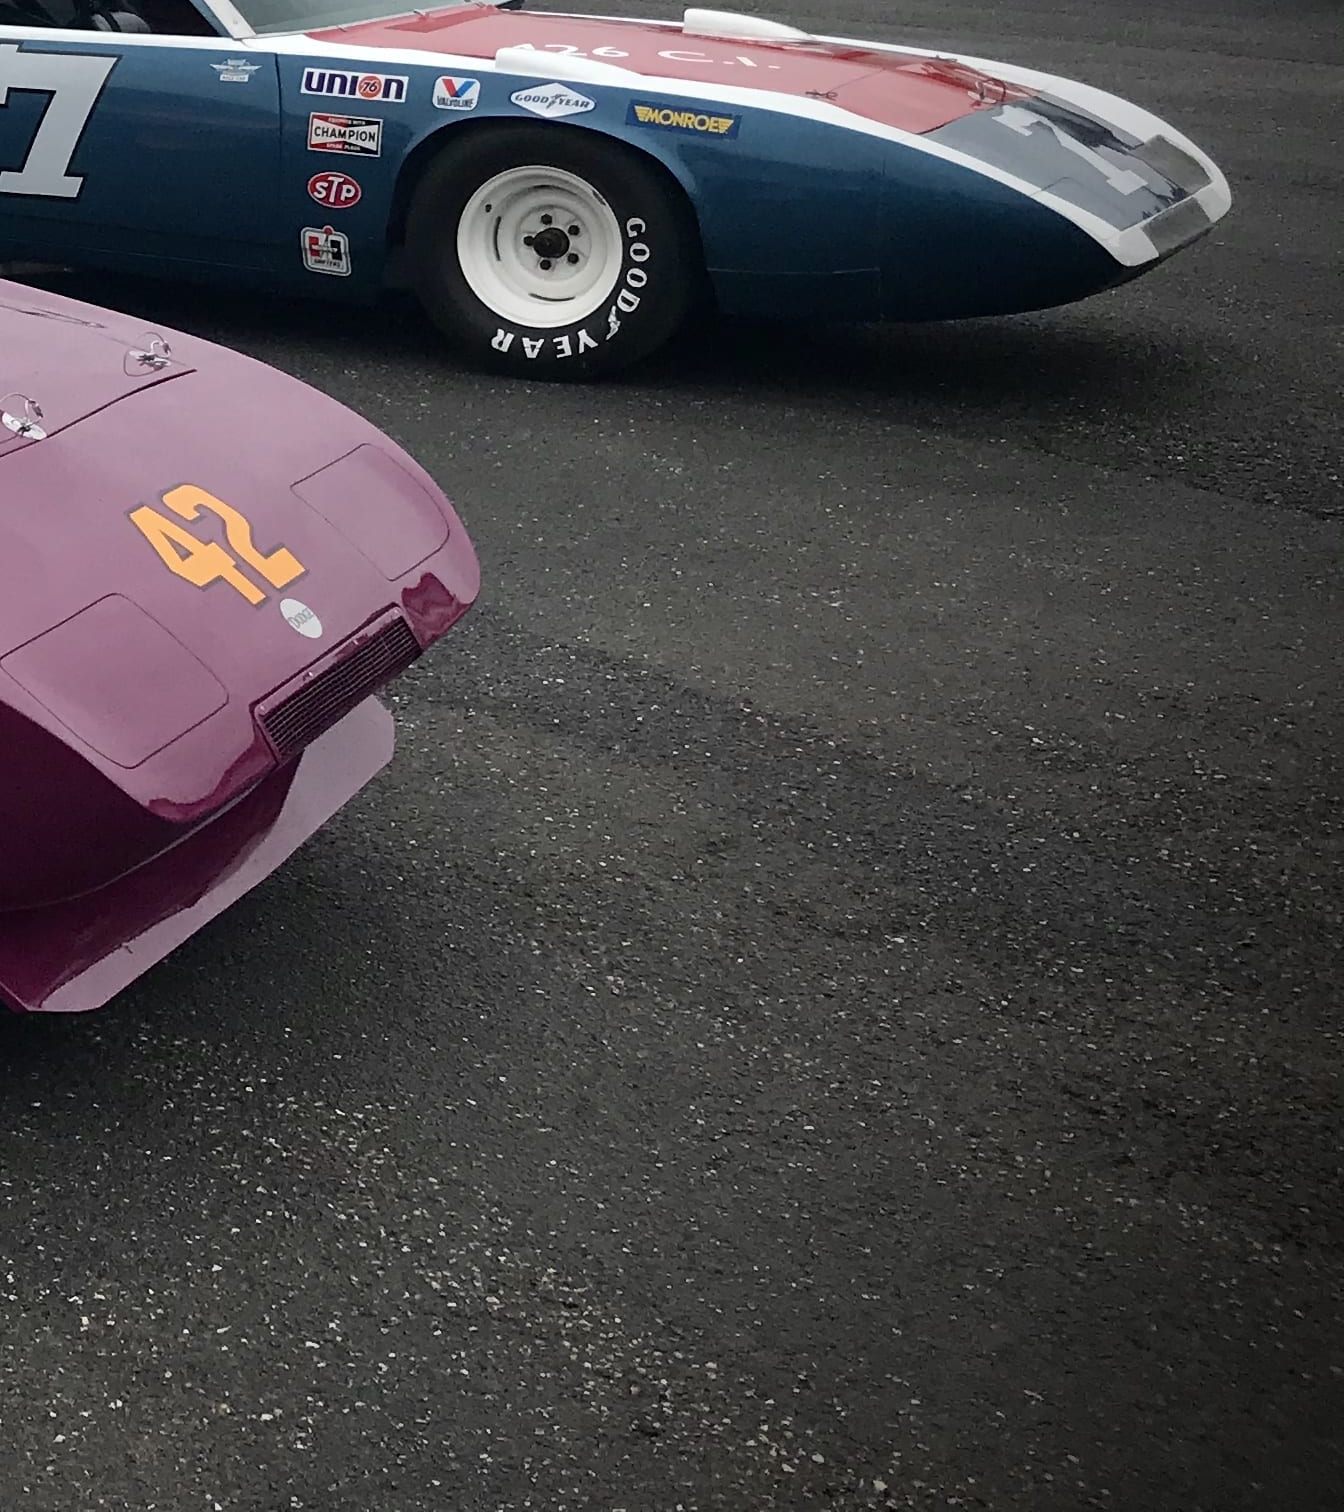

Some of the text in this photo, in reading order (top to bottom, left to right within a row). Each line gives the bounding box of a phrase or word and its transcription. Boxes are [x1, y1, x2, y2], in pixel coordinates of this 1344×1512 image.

[361, 81, 378, 93] 76
[644, 107, 723, 133] MONROE
[314, 126, 376, 143] CHAMPION
[313, 176, 355, 203] STP
[128, 483, 308, 607] 42
